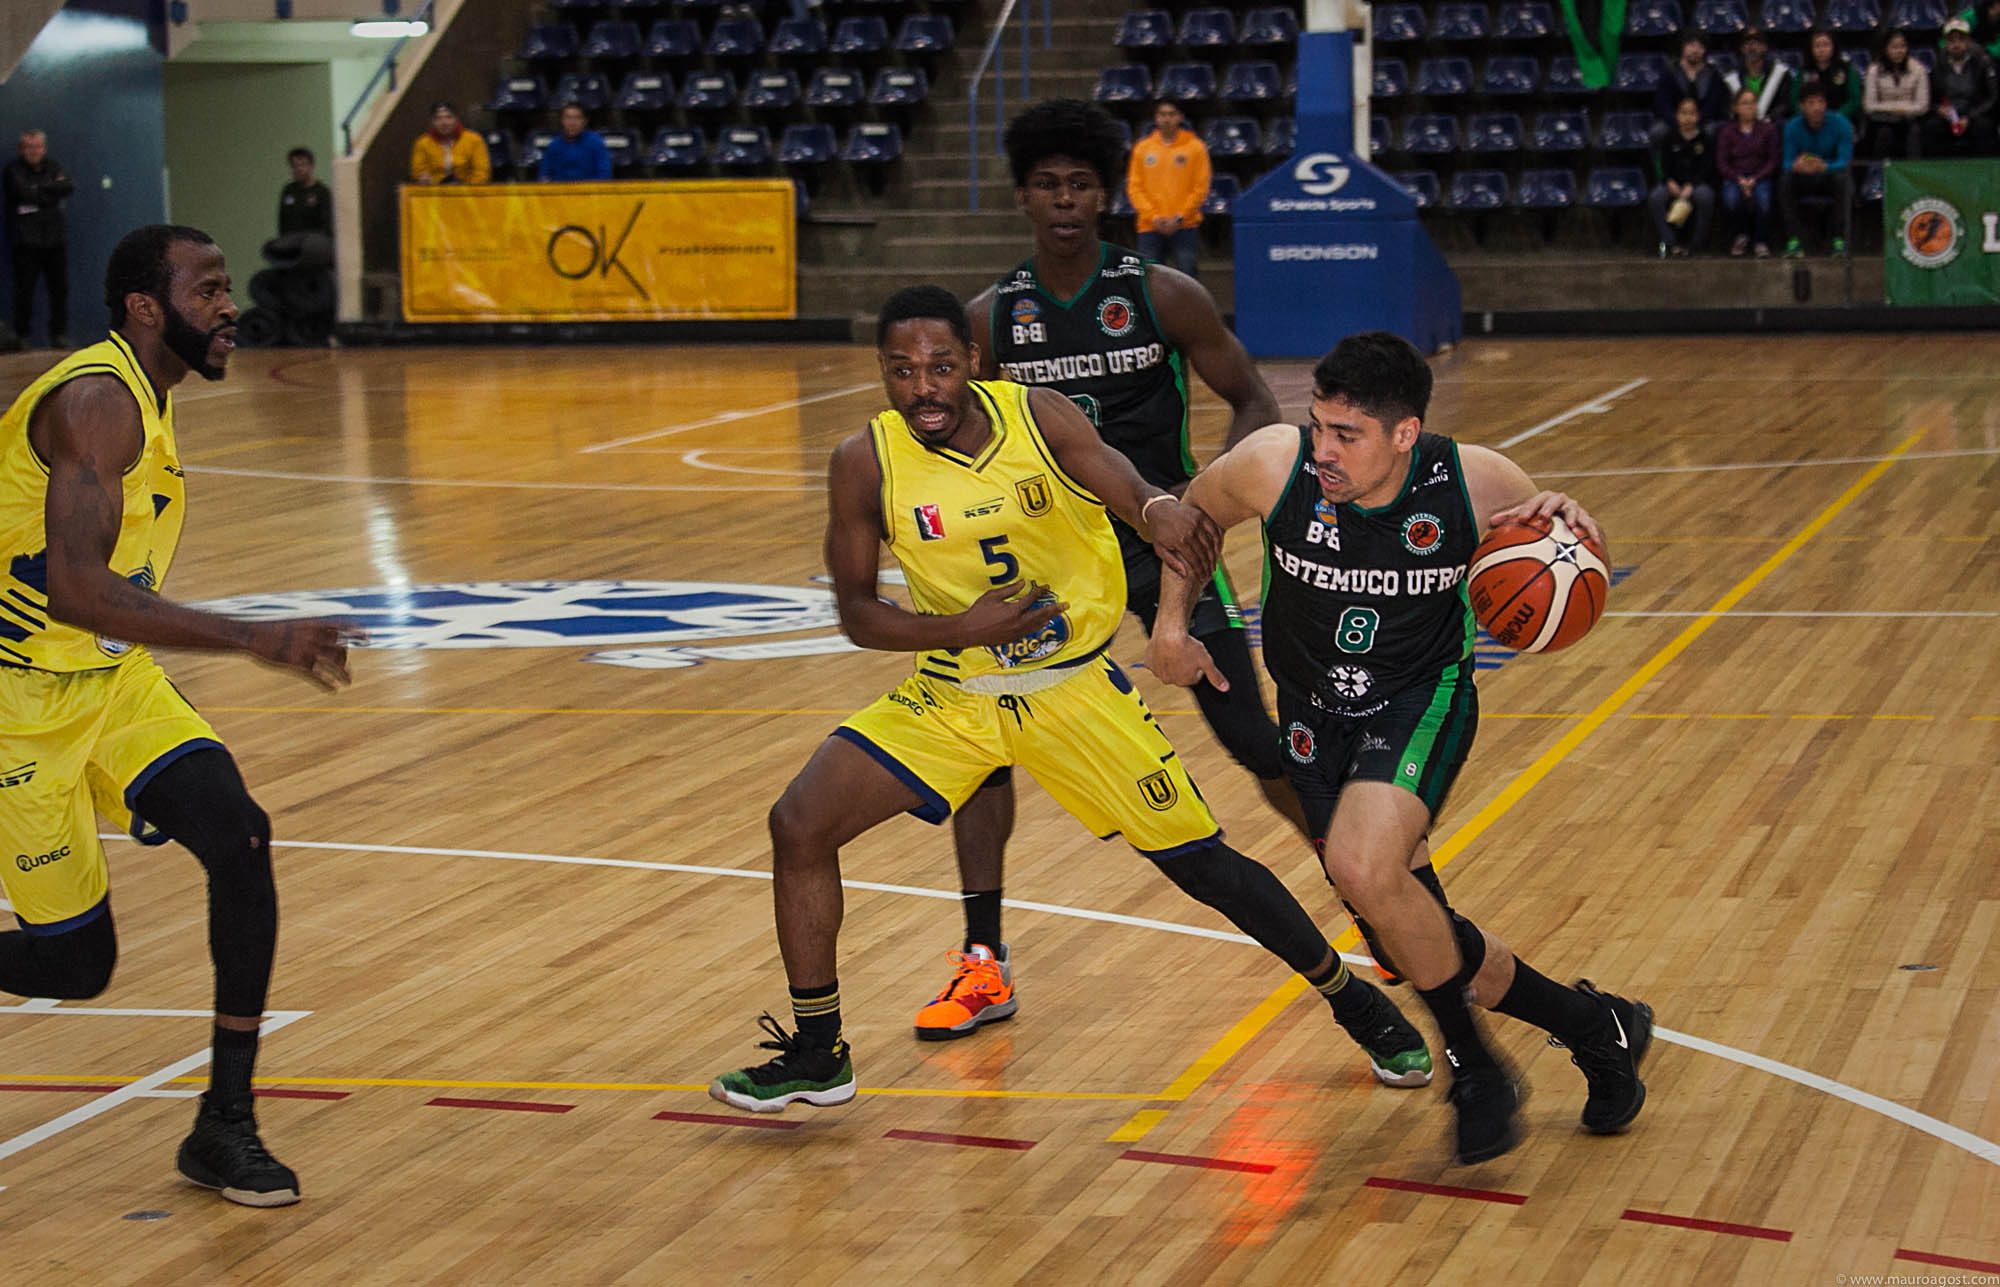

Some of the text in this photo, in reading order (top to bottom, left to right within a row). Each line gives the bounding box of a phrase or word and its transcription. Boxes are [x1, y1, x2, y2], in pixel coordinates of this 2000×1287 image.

[1329, 199, 1377, 212] Sports
[547, 200, 649, 301] OK
[1269, 246, 1379, 261] BRONSON
[1000, 343, 1164, 384] BTEMUCO UFRO
[979, 534, 1019, 585] 5
[1273, 543, 1468, 596] ABTEMUCO UFRO
[1335, 606, 1380, 653] 8
[1404, 762, 1417, 777] 8
